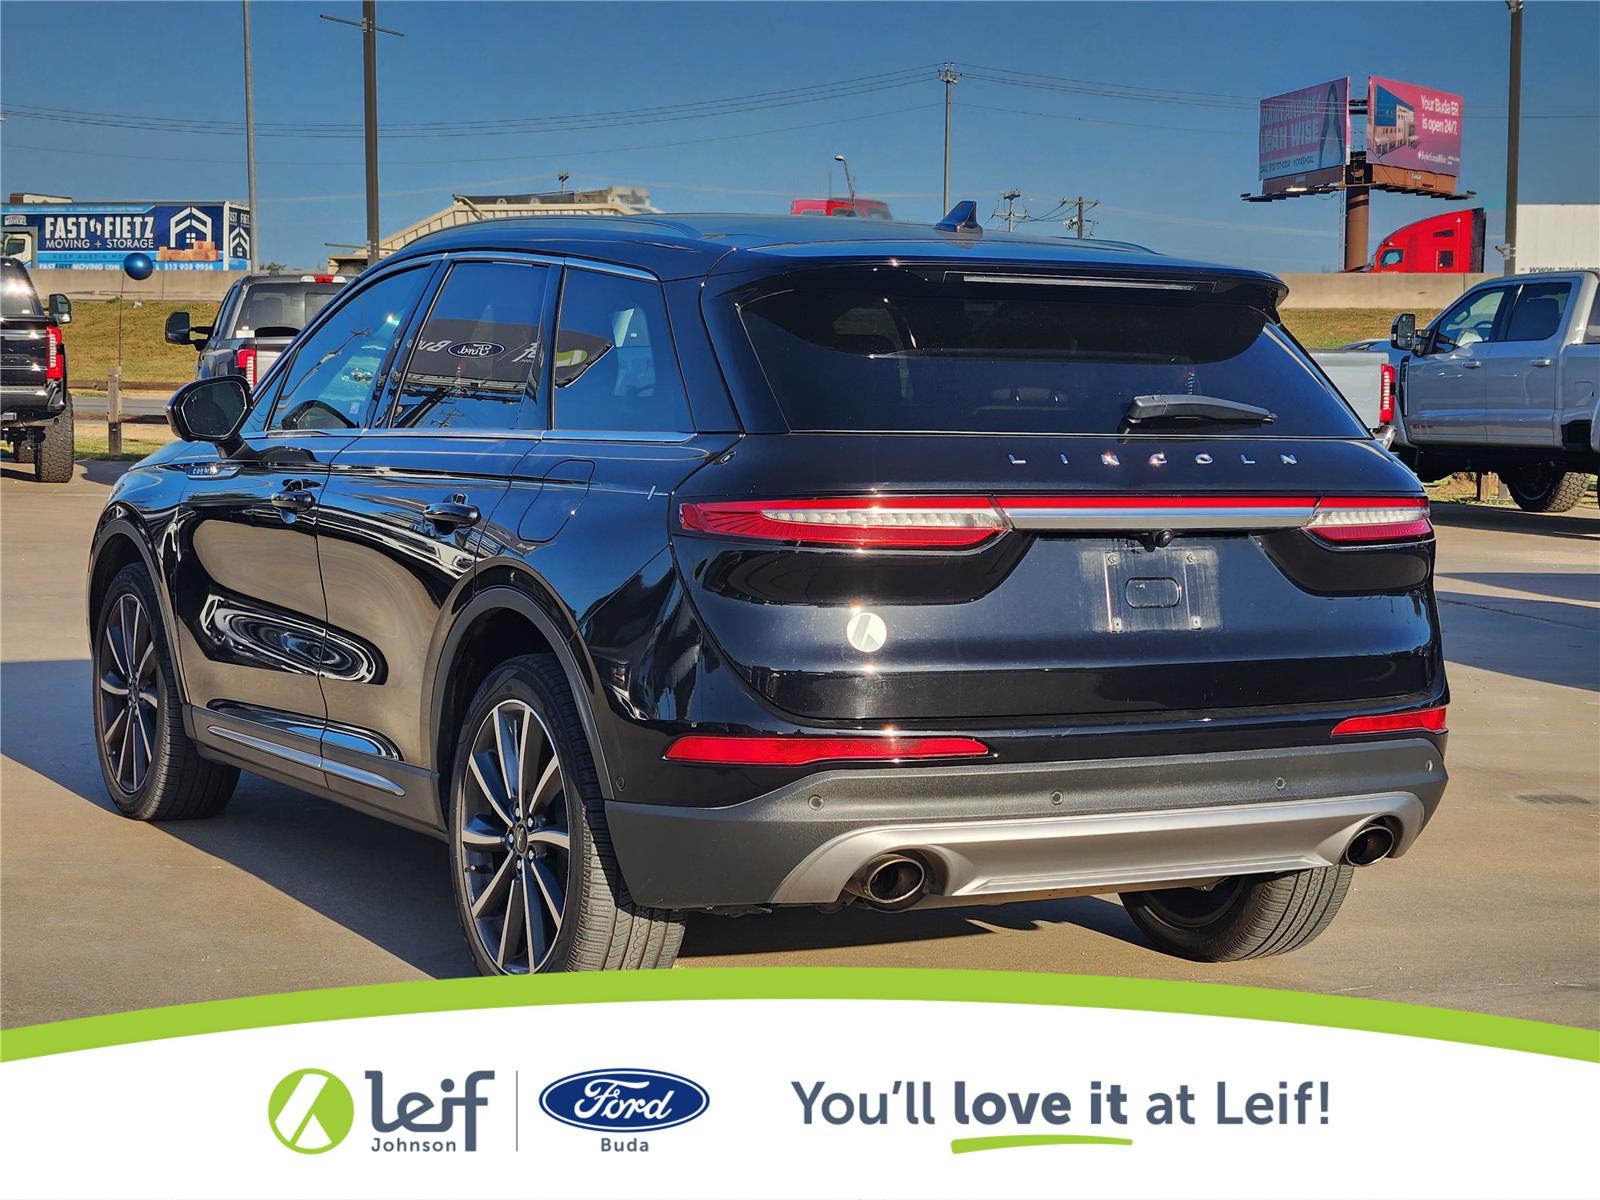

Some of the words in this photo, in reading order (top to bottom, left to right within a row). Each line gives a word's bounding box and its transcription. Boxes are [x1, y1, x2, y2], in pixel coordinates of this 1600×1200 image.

[1420, 94, 1435, 111] Your
[1435, 98, 1451, 115] Buda
[1422, 113, 1428, 129] is
[1428, 119, 1444, 134] open
[45, 217, 88, 239] FAST
[104, 216, 155, 239] FIETZ
[45, 239, 91, 249] MOVING
[106, 239, 155, 249] STORAGE
[1008, 453, 1298, 466] LINCOLN
